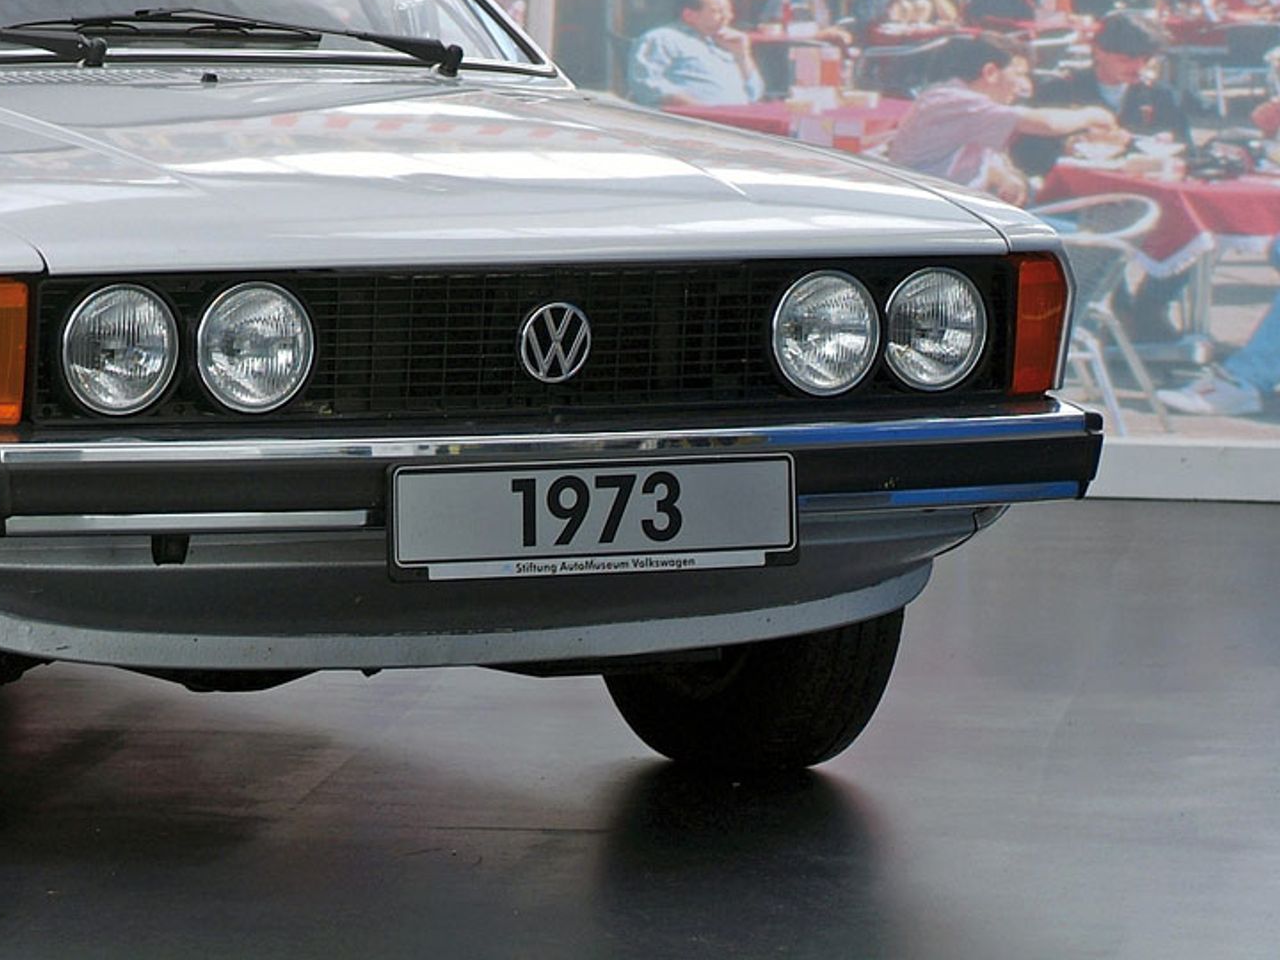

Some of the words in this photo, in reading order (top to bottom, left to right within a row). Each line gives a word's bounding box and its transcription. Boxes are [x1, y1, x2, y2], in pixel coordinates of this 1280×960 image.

[522, 303, 590, 382] VW
[511, 471, 683, 547] 1973
[515, 561, 557, 575] Stiftung
[559, 559, 630, 572] AutoMuseum
[632, 556, 696, 569] Volkswagen
